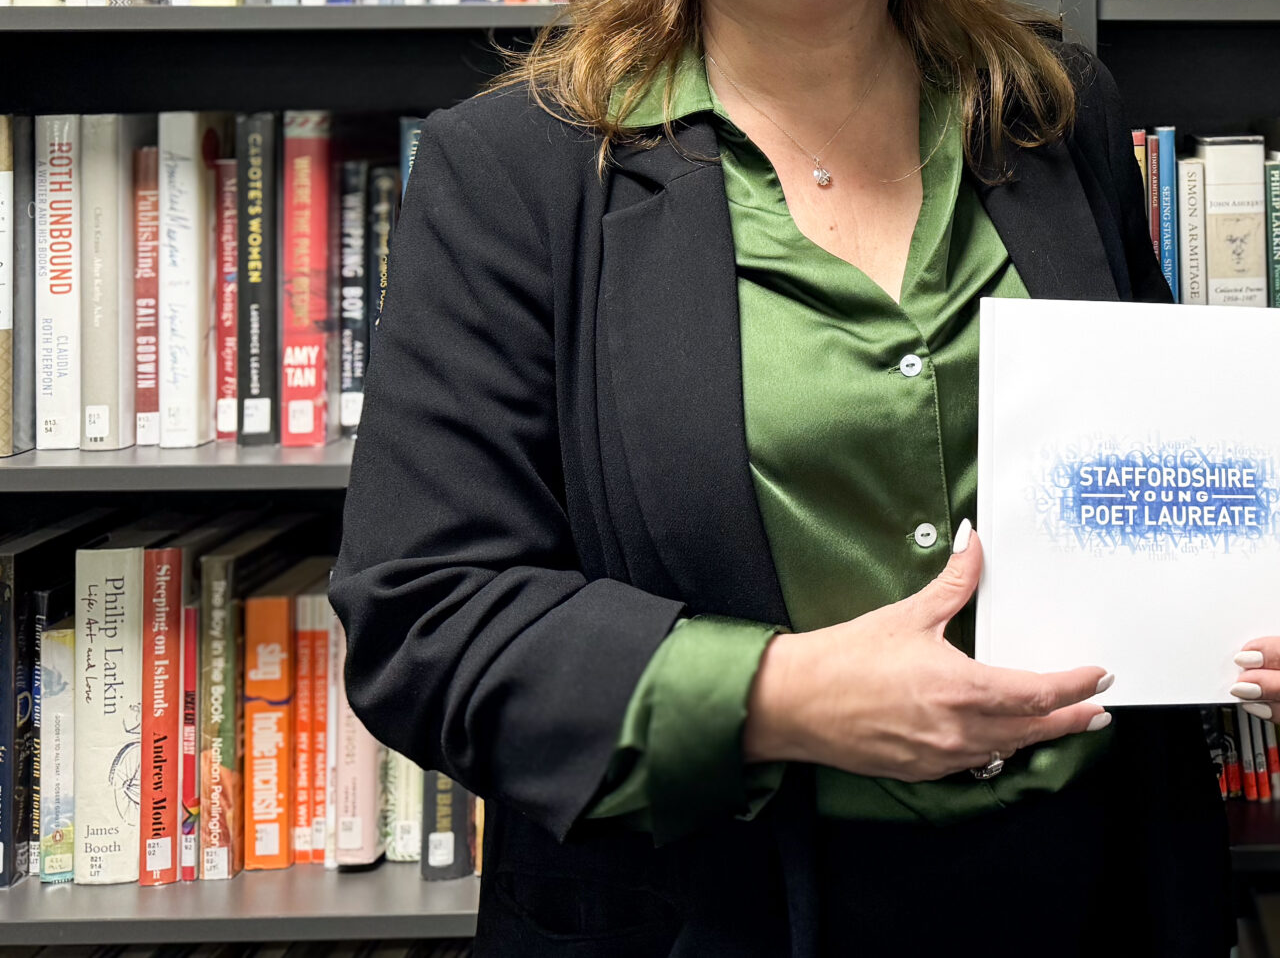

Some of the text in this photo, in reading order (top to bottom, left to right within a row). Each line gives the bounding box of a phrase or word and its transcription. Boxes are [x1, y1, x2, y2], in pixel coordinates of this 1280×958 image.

[247, 133, 264, 215] CAPOTE'S
[292, 155, 313, 204] WHERE
[37, 160, 48, 277] A WRITER AND HIS BOOKS
[49, 143, 73, 296] ROTH UNBOUND
[1160, 186, 1172, 251] SEEING STARS
[1209, 200, 1231, 208] JOHN
[292, 209, 312, 234] THE
[1186, 171, 1200, 299] SIMON ARMITAGE
[220, 178, 238, 329] Mockingbird Songs
[247, 218, 264, 283] WOMEN
[135, 189, 158, 390] Publishing GAIL GODWIN
[341, 286, 364, 321] BOY
[41, 318, 53, 397] ROTH PIERPONT
[56, 335, 69, 379] CLAUDIA
[284, 346, 320, 365] AMY
[285, 367, 317, 387] TAN
[1080, 466, 1255, 488] STAFFORDSHIRE
[1128, 490, 1209, 503] YOUNG
[1081, 505, 1257, 526] POET LAUREATE
[209, 580, 227, 607] The
[85, 617, 99, 644] Art
[208, 609, 227, 637] Boy
[84, 647, 96, 673] and
[99, 575, 126, 717] Philip Larkin
[210, 642, 226, 655] in
[249, 643, 287, 681] slug
[210, 657, 227, 682] the
[84, 676, 98, 705] Love
[151, 562, 173, 839] Sleeping on Islands Andrew Motio
[209, 685, 227, 724] Book
[297, 731, 310, 750] MY
[314, 731, 327, 750] MY
[210, 738, 224, 784] Nathan
[252, 711, 286, 821] hollie mcnish
[297, 752, 310, 787] NAME
[314, 752, 327, 787] NAME
[297, 789, 310, 802] IS
[314, 789, 327, 802] IS
[84, 825, 120, 839] James
[84, 841, 121, 854] Booth
